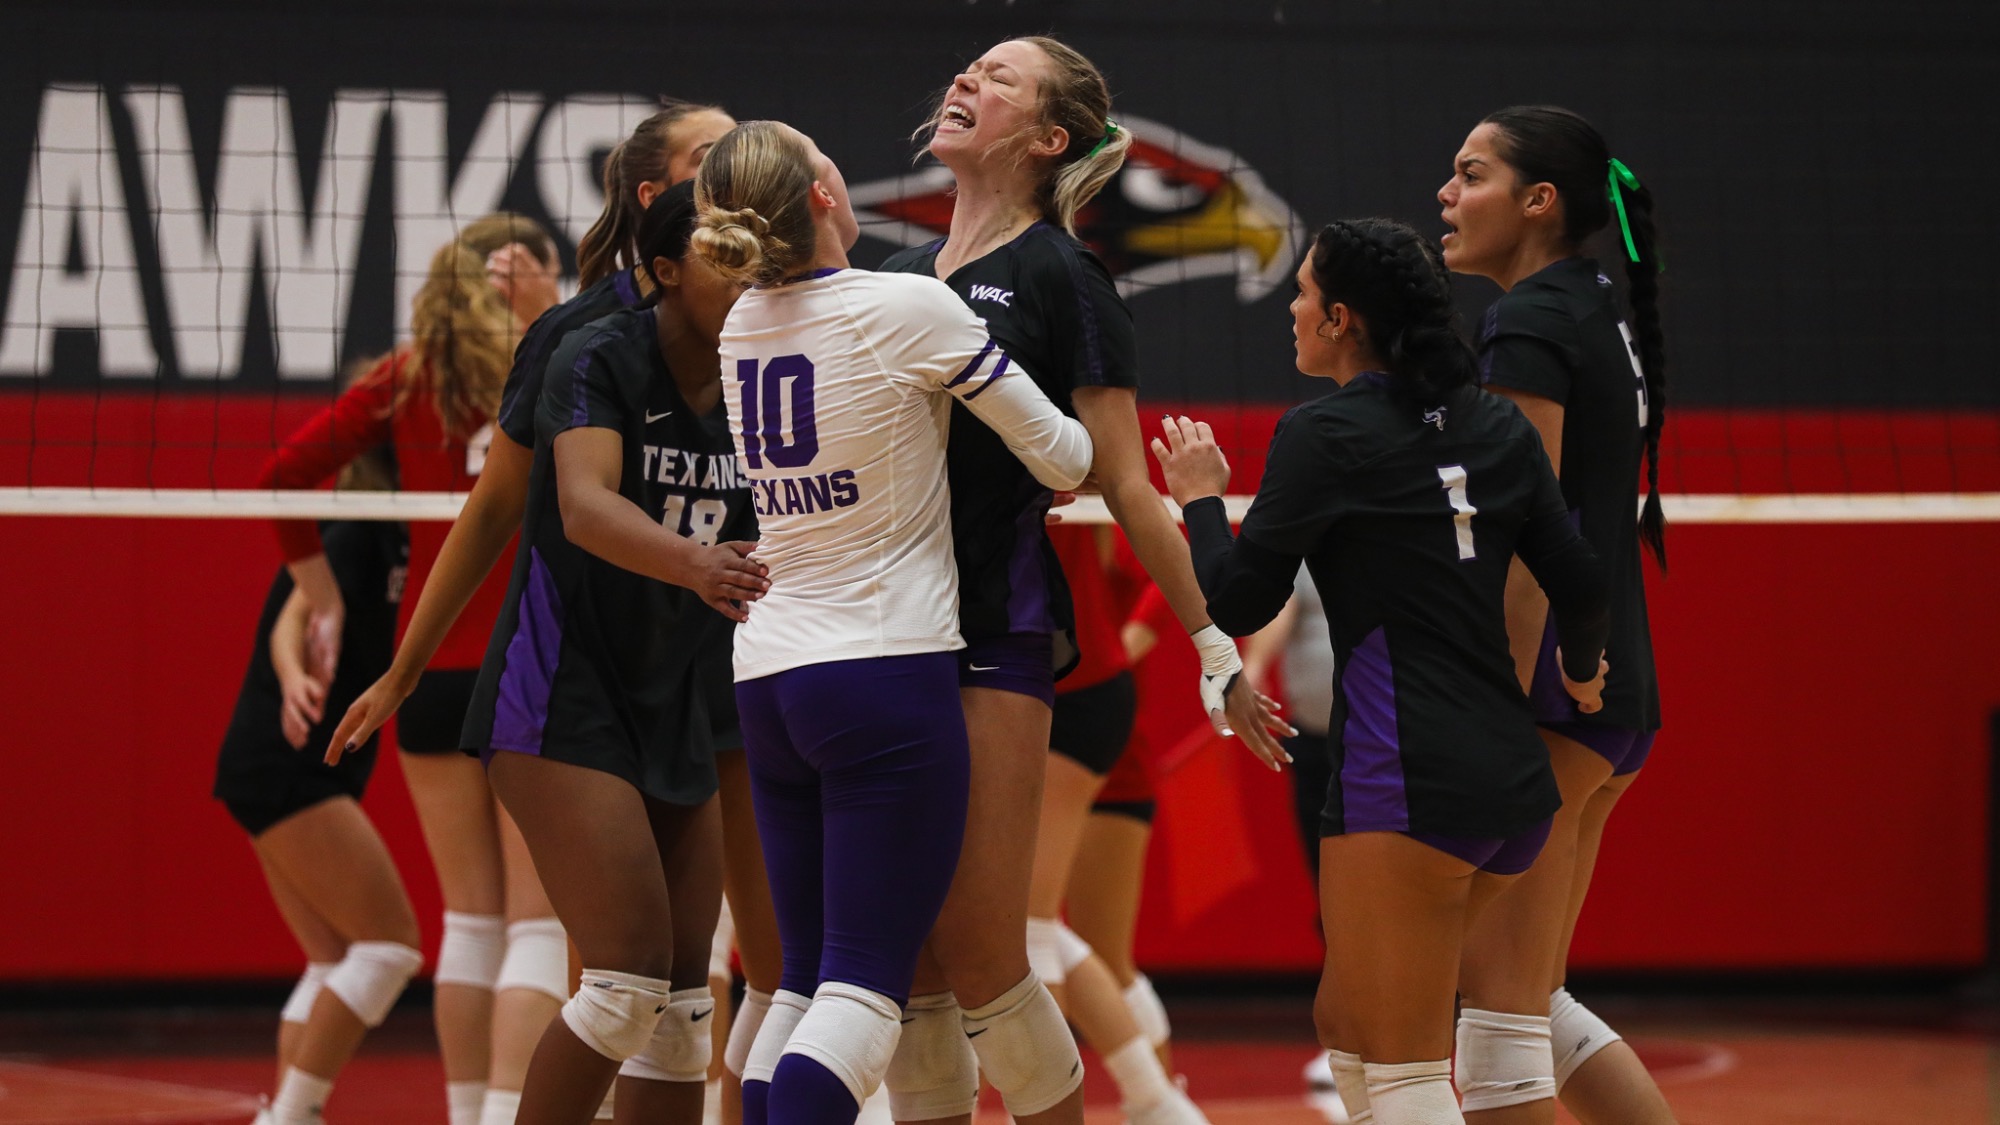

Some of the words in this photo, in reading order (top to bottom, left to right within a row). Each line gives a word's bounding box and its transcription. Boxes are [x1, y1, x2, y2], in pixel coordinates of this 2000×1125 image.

[970, 284, 1014, 308] WAC
[736, 353, 820, 470] 10
[749, 469, 860, 516] EXANS
[1436, 464, 1478, 562] 1
